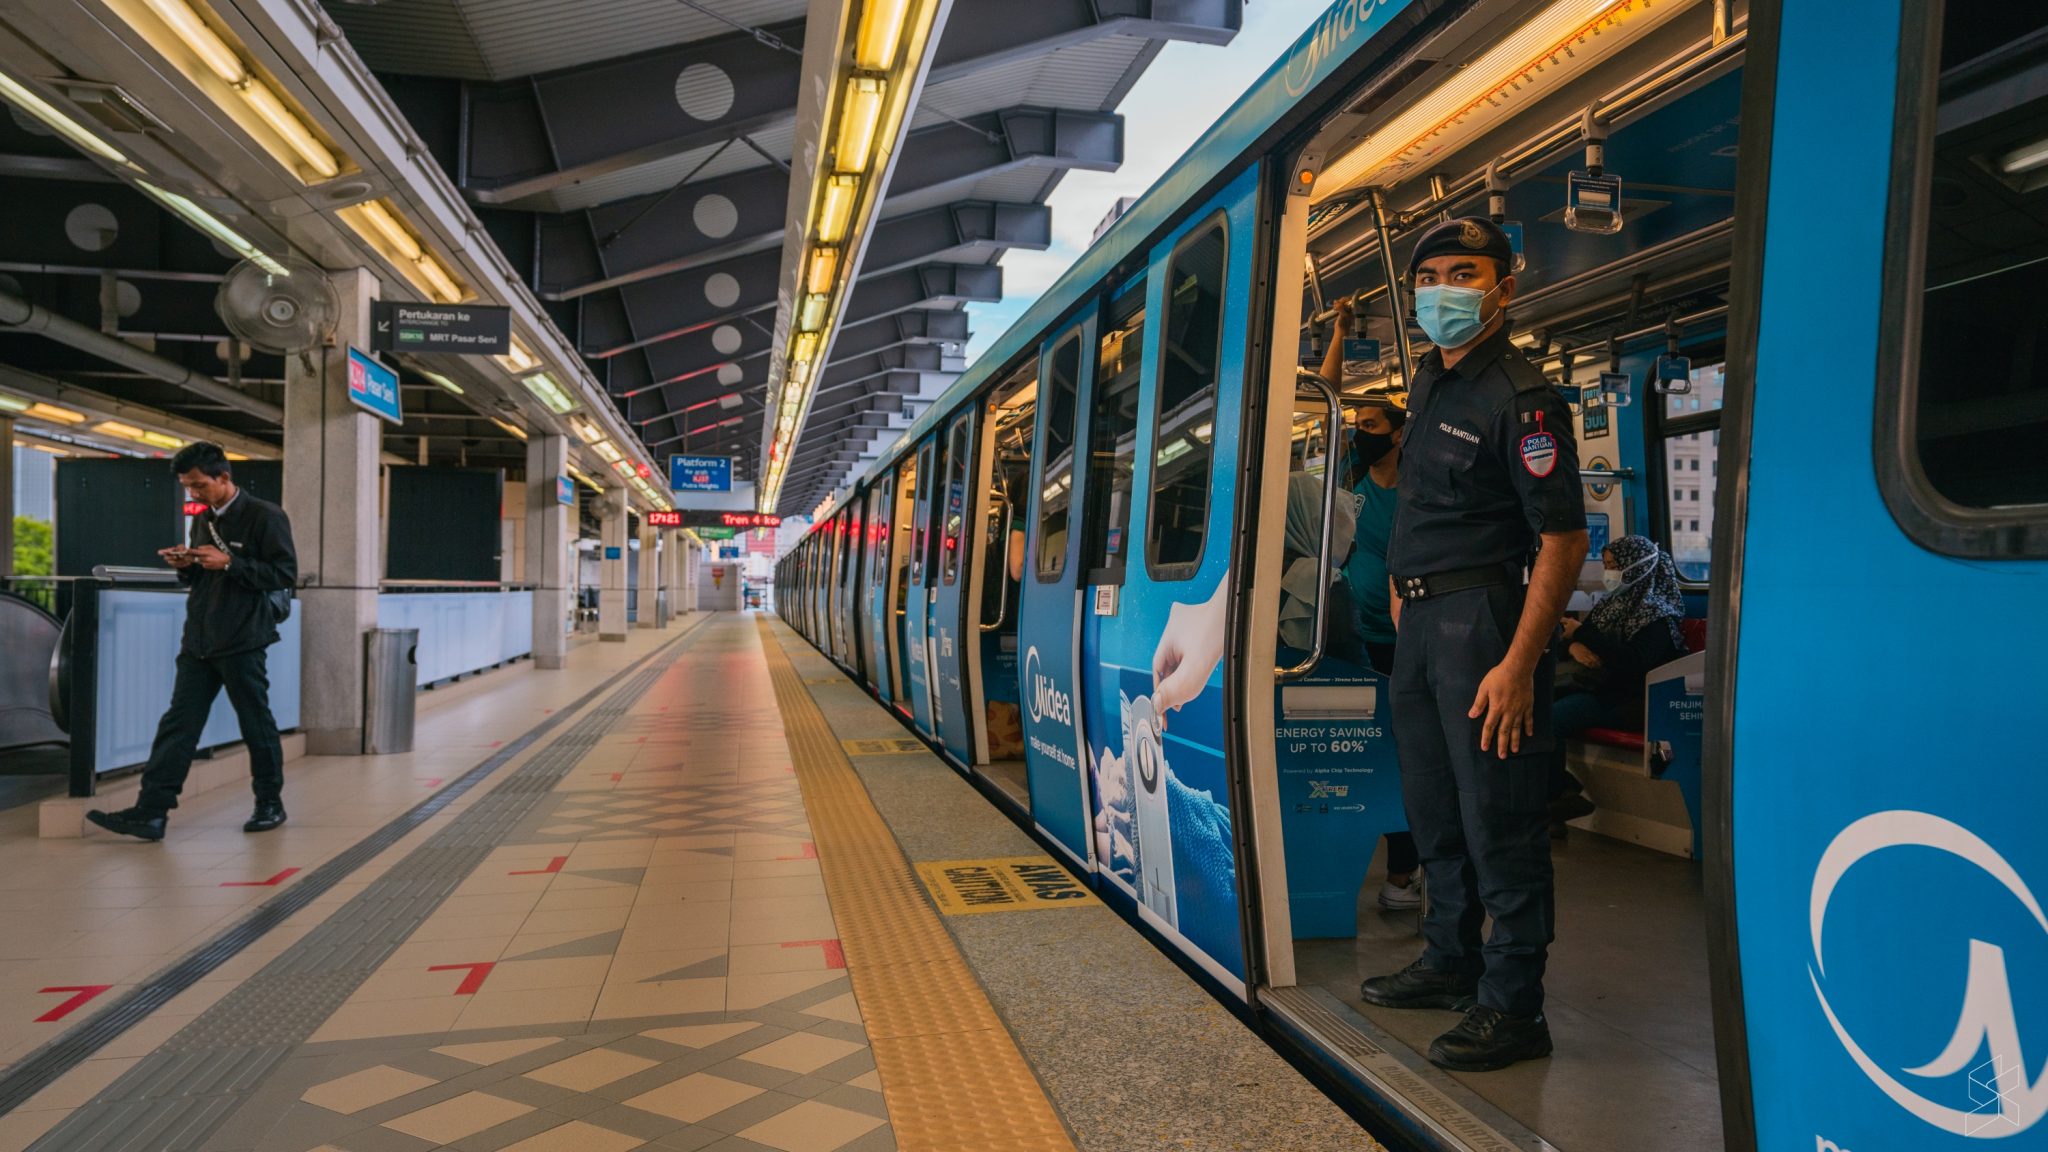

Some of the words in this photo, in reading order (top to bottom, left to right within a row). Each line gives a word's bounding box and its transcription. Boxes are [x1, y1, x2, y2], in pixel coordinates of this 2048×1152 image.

[1285, 0, 1388, 97] Mide
[399, 309, 456, 321] Pertukaran
[457, 312, 471, 322] ke
[429, 333, 450, 342] MRT
[451, 334, 476, 343] Pasar
[478, 335, 498, 344] Seni
[1439, 422, 1453, 433] POLIS
[1452, 428, 1480, 444] BANTUAN
[1523, 441, 1553, 453] BANTUAN
[1527, 436, 1547, 446] POLIS
[677, 457, 717, 467] Platform
[719, 459, 726, 468] 2
[649, 514, 680, 524] 17:21
[722, 514, 749, 525] Tren
[752, 514, 760, 525] 4
[1026, 645, 1071, 726] Midea
[1276, 728, 1326, 738] ENERGY
[1329, 727, 1382, 738] SAVINGS
[1030, 736, 1041, 751] make
[1041, 742, 1057, 760] yourself
[1290, 743, 1307, 753] UP
[1311, 743, 1327, 753] TO
[943, 866, 1015, 906] CAUTION
[1010, 864, 1087, 900] AWAS
